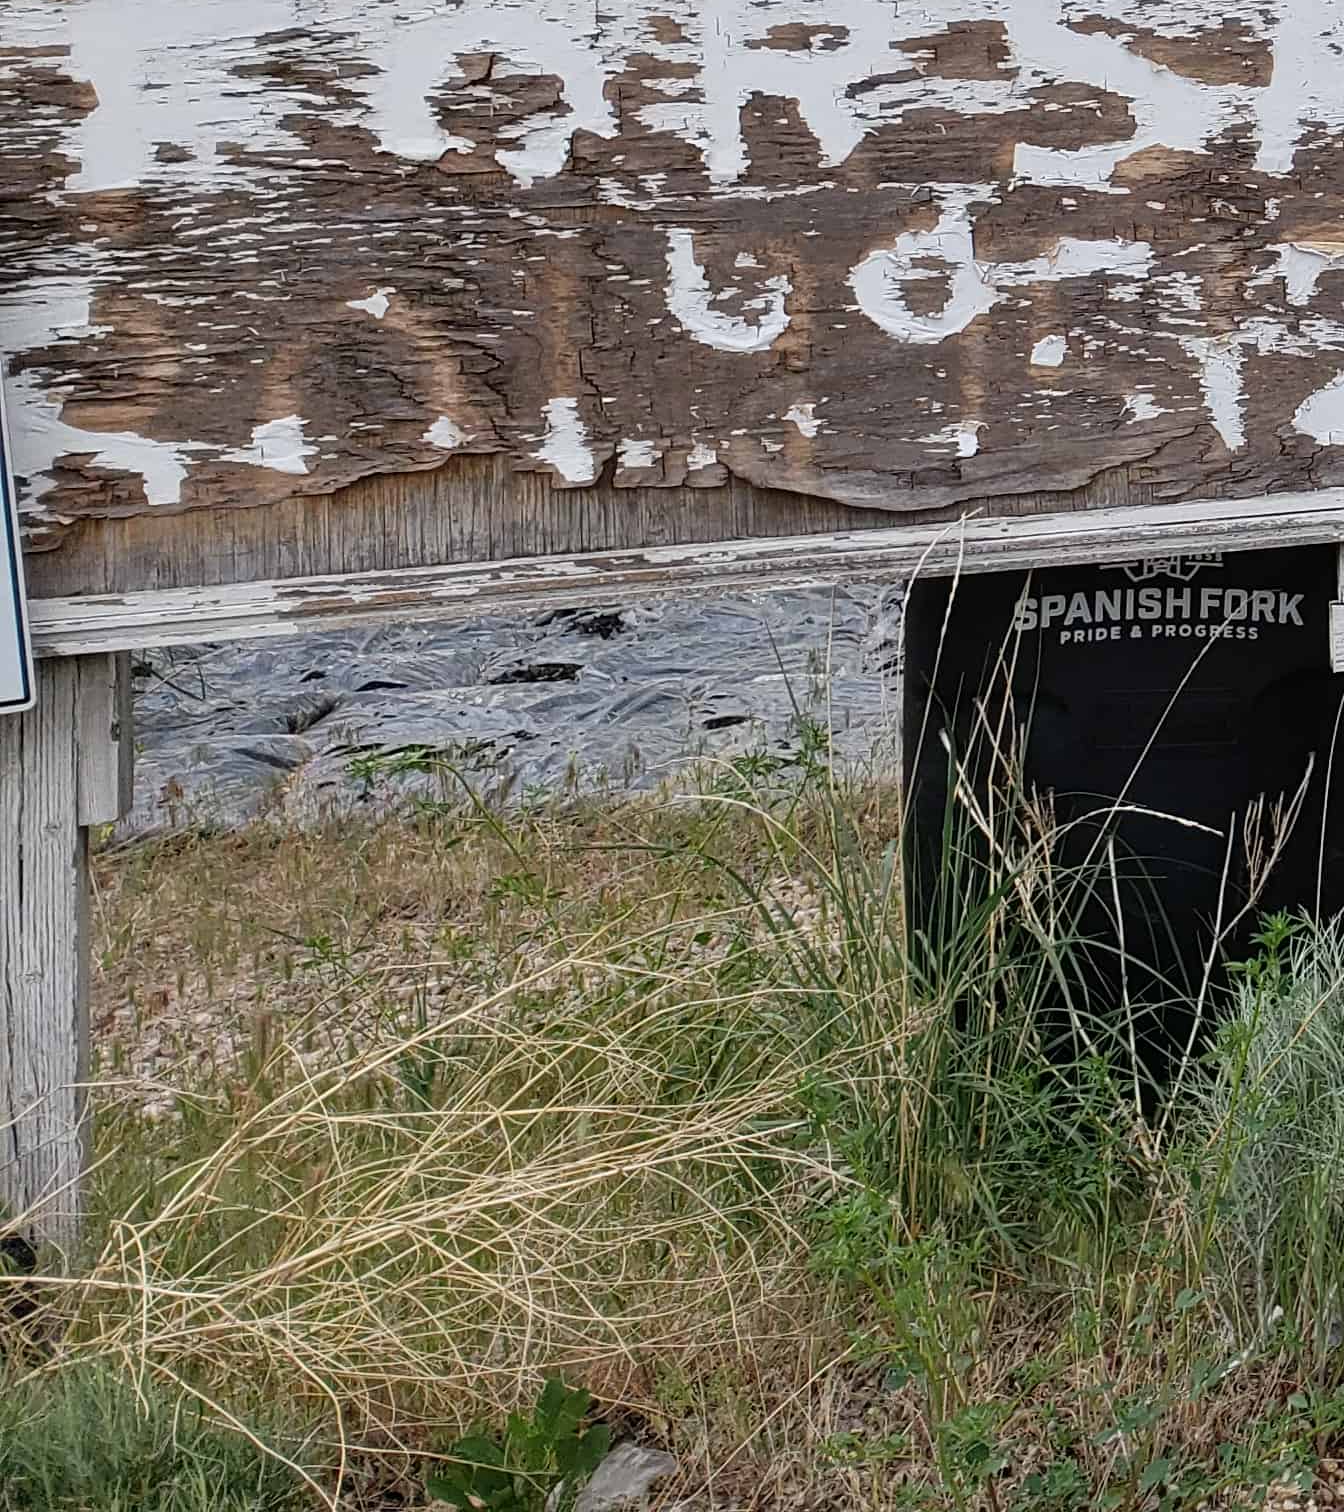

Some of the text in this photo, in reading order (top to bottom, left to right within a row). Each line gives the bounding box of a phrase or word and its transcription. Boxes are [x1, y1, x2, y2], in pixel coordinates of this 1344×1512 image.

[1014, 587, 1305, 632] SPANISH FORK
[1060, 623, 1259, 645] PRIDE & PROGRESS
